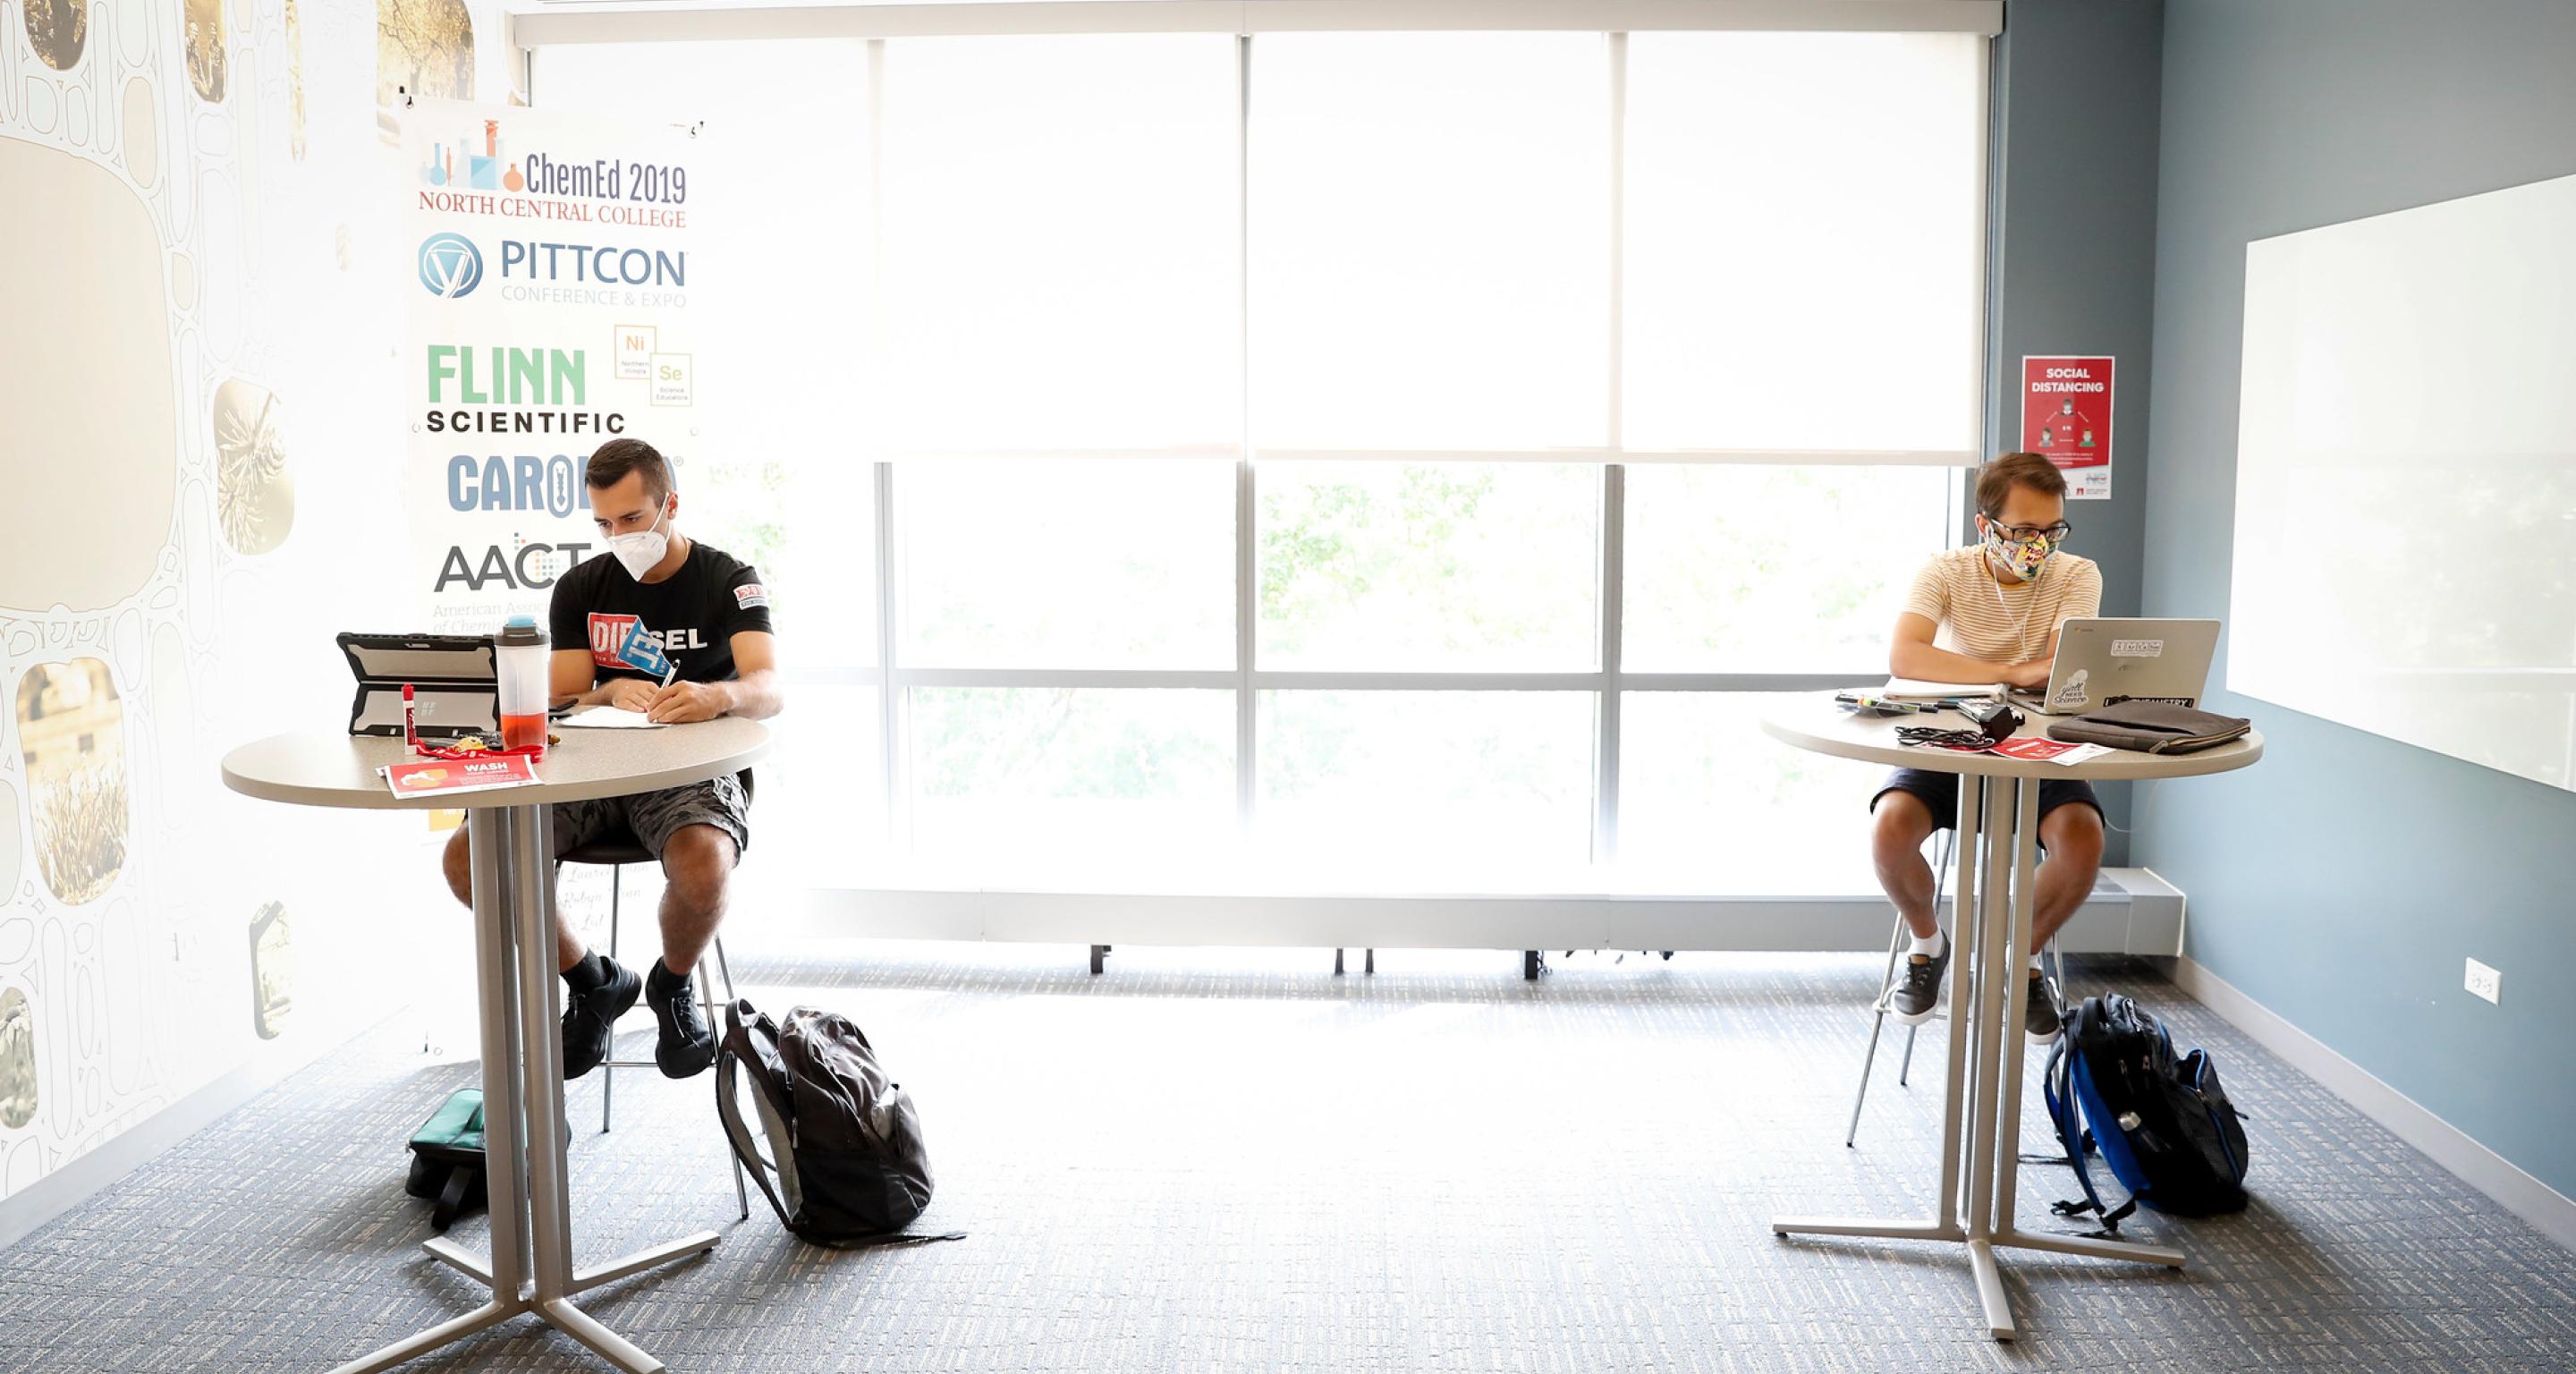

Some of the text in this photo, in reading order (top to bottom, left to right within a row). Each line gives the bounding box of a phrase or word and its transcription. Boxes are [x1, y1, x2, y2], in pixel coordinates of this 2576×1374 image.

[526, 153, 686, 204] ChemEd 2019
[419, 191, 686, 228] NORTH CENTRAL COLLEGE
[501, 240, 685, 286] PITTCON
[501, 285, 686, 308] CONFERENCE & EXPO
[626, 335, 644, 352] Ni
[428, 344, 586, 405] FLINN
[659, 365, 682, 380] Se
[2046, 368, 2090, 379] SOCIAL
[2032, 382, 2104, 393] DISTANCING
[427, 411, 625, 435] SCIENTIFIC
[434, 542, 591, 592] AACT
[433, 602, 548, 617] American Associ
[464, 761, 508, 772] WASH
